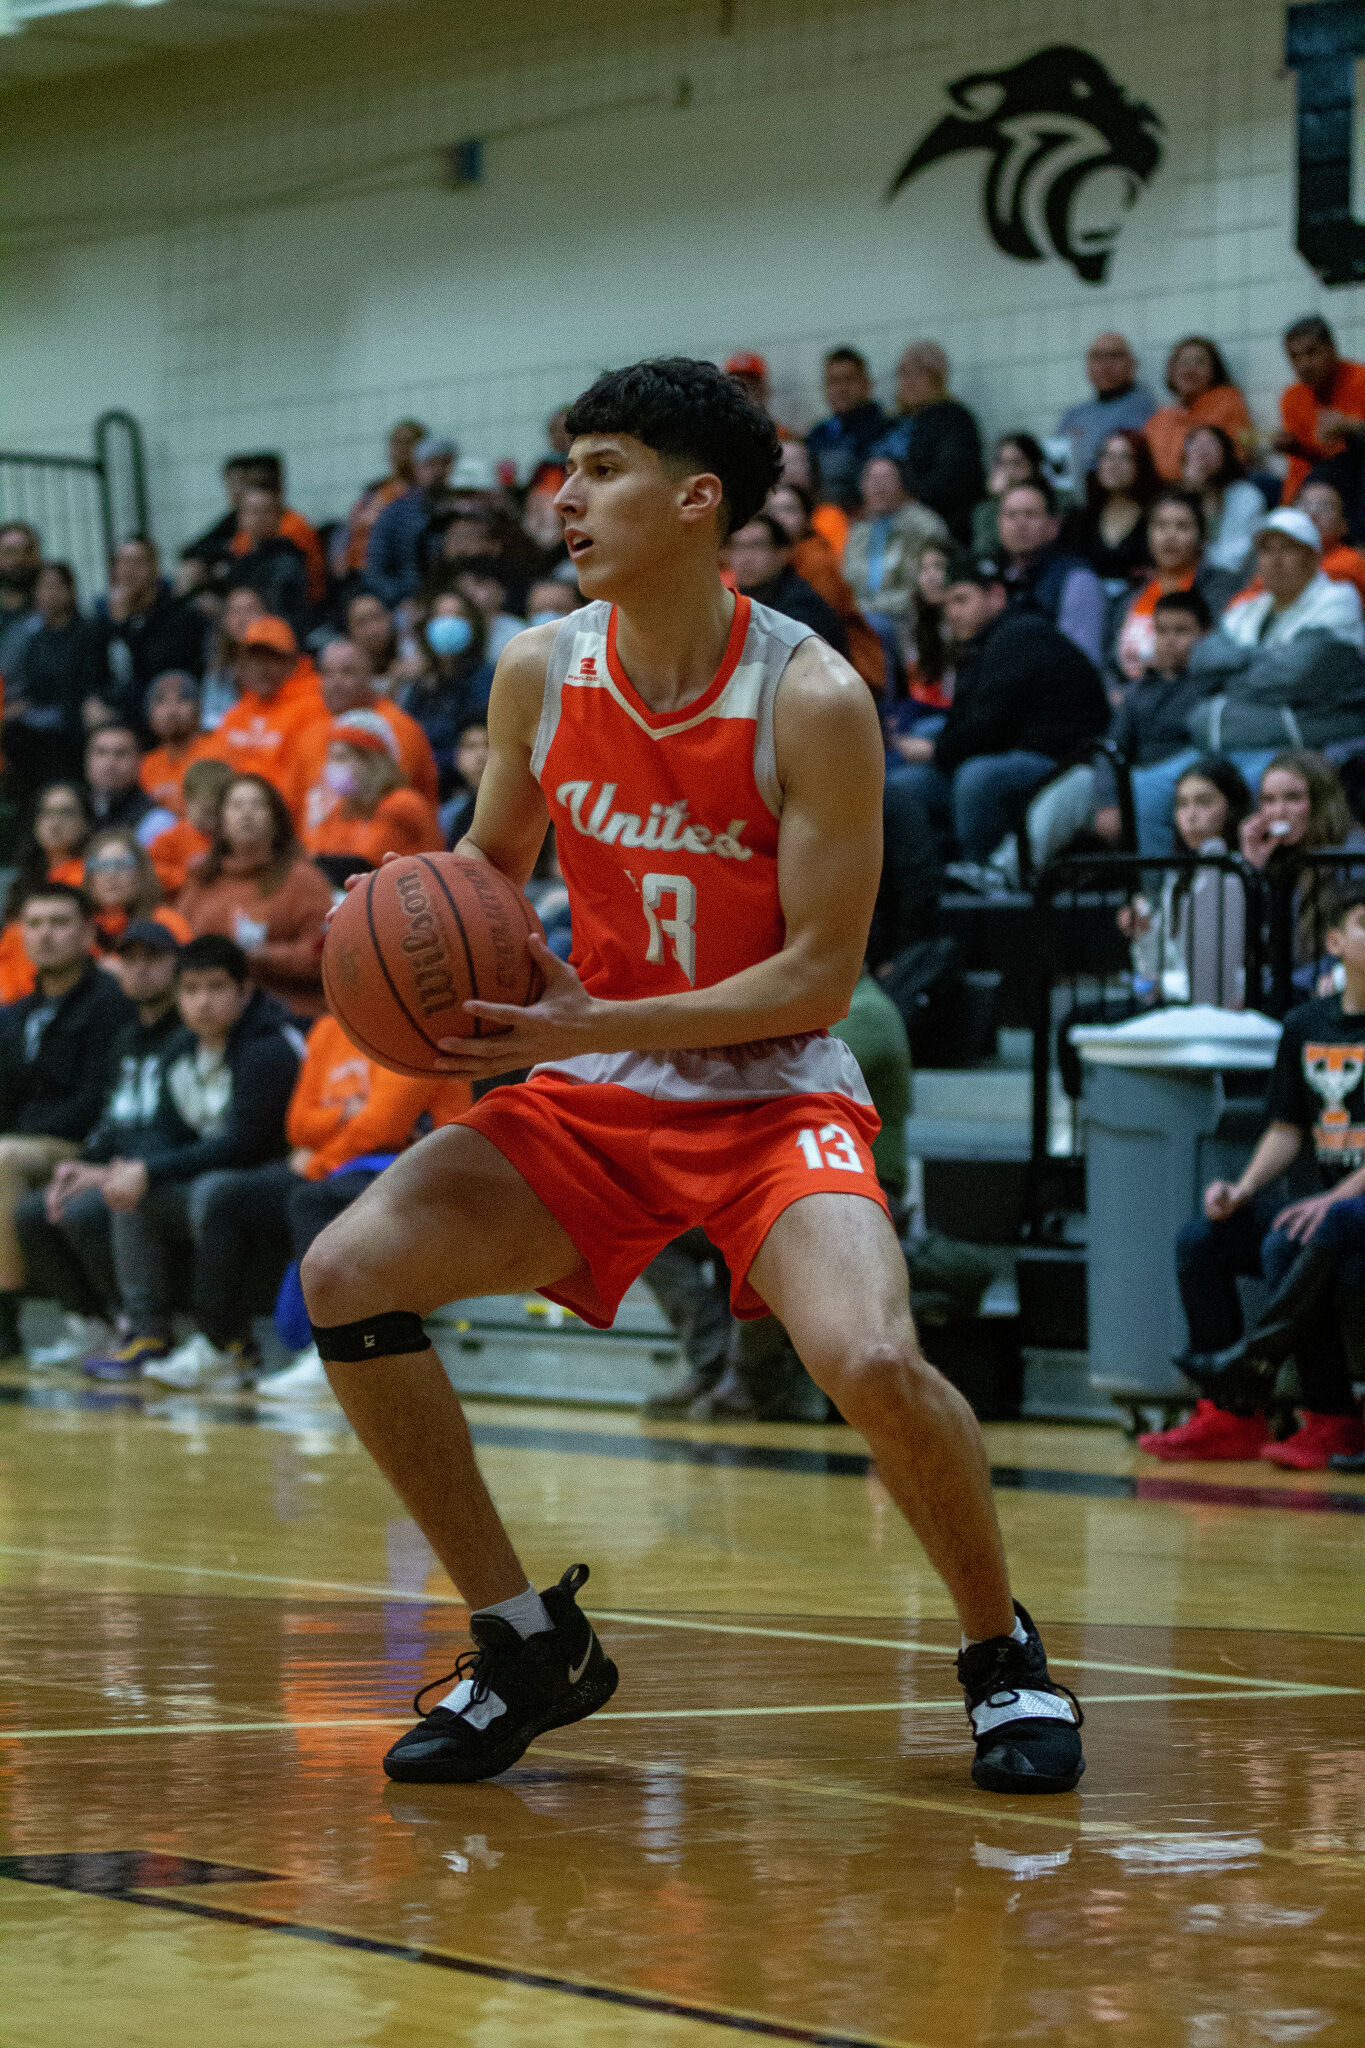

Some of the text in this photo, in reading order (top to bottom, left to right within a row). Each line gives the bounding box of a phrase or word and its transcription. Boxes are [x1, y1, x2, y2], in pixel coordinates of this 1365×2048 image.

[556, 780, 753, 861] United
[397, 871, 458, 1018] Wilson
[796, 1123, 864, 1174] 13
